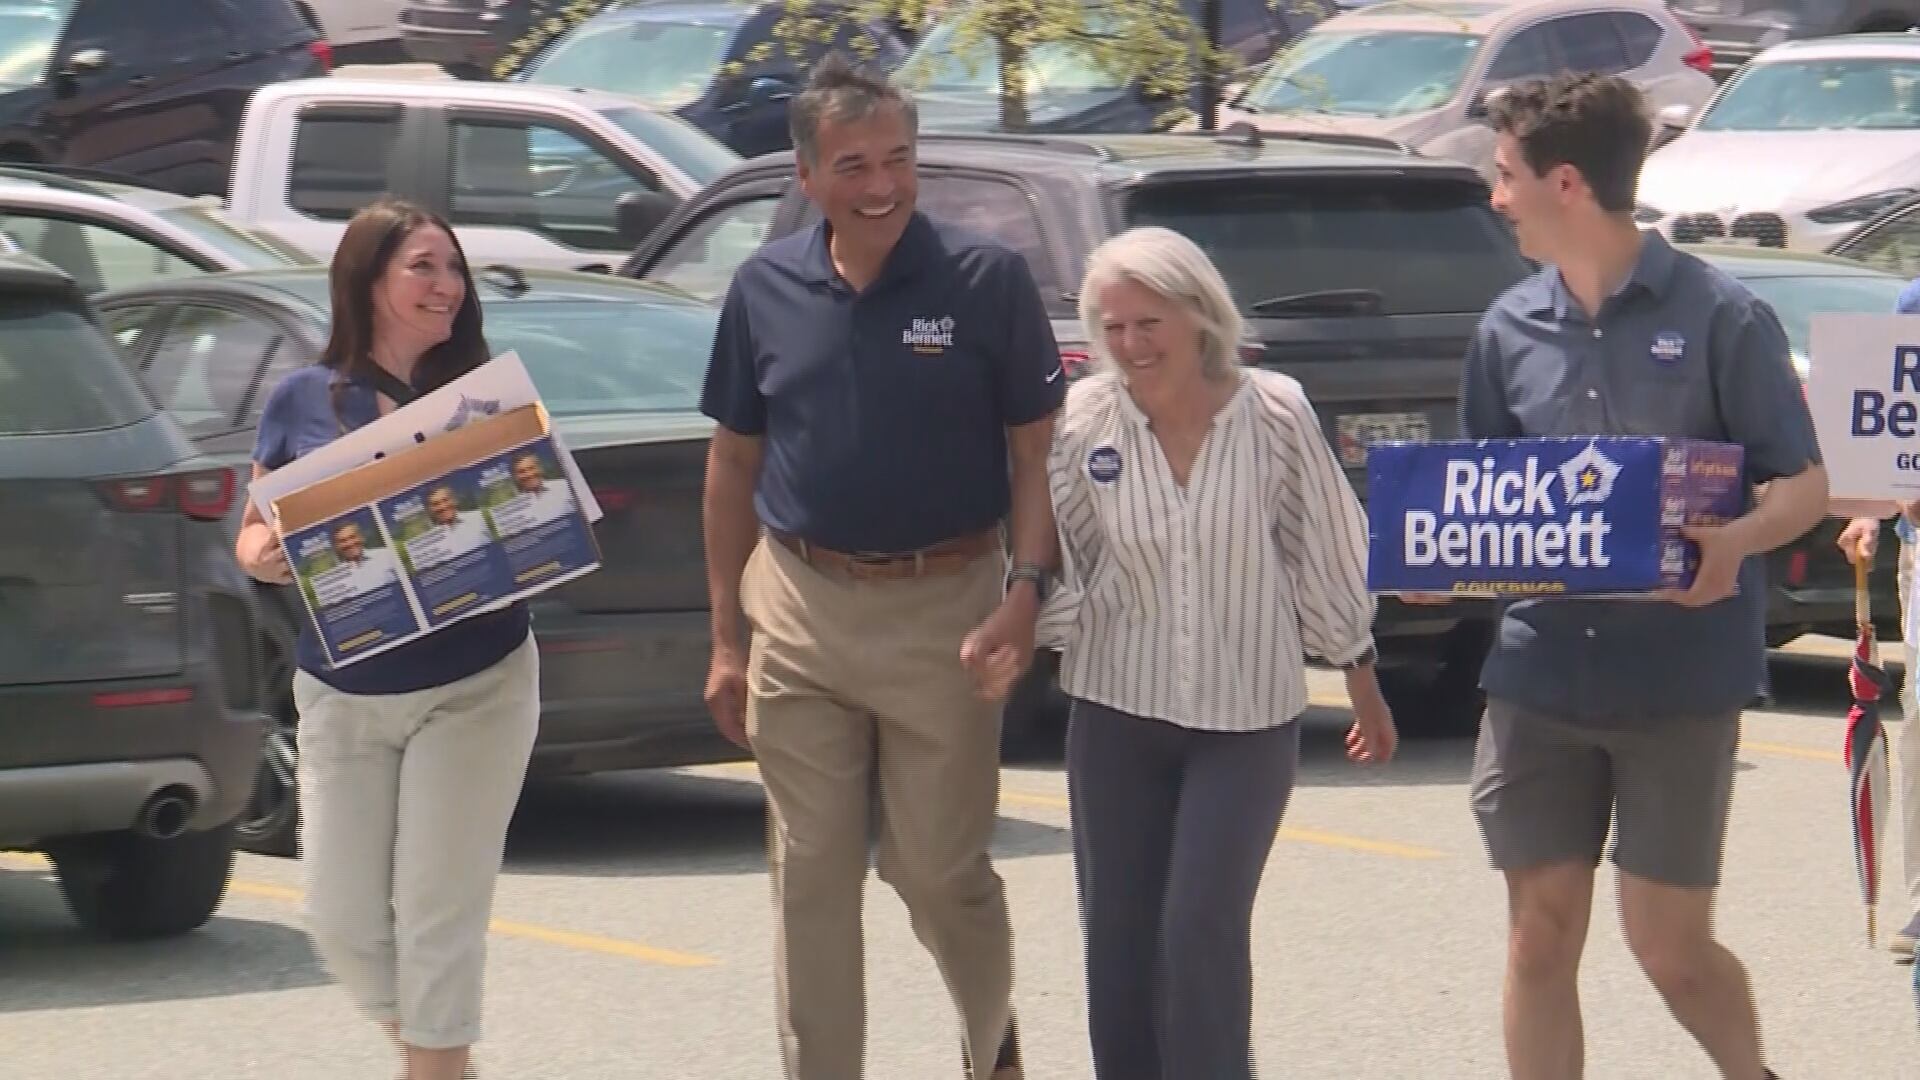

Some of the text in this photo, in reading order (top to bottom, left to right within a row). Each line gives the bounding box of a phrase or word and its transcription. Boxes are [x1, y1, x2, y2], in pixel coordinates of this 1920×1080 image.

[902, 329, 953, 346] Bennett
[912, 317, 940, 332] Rick
[1442, 455, 1558, 517] Rick
[1404, 509, 1612, 568] Bennett
